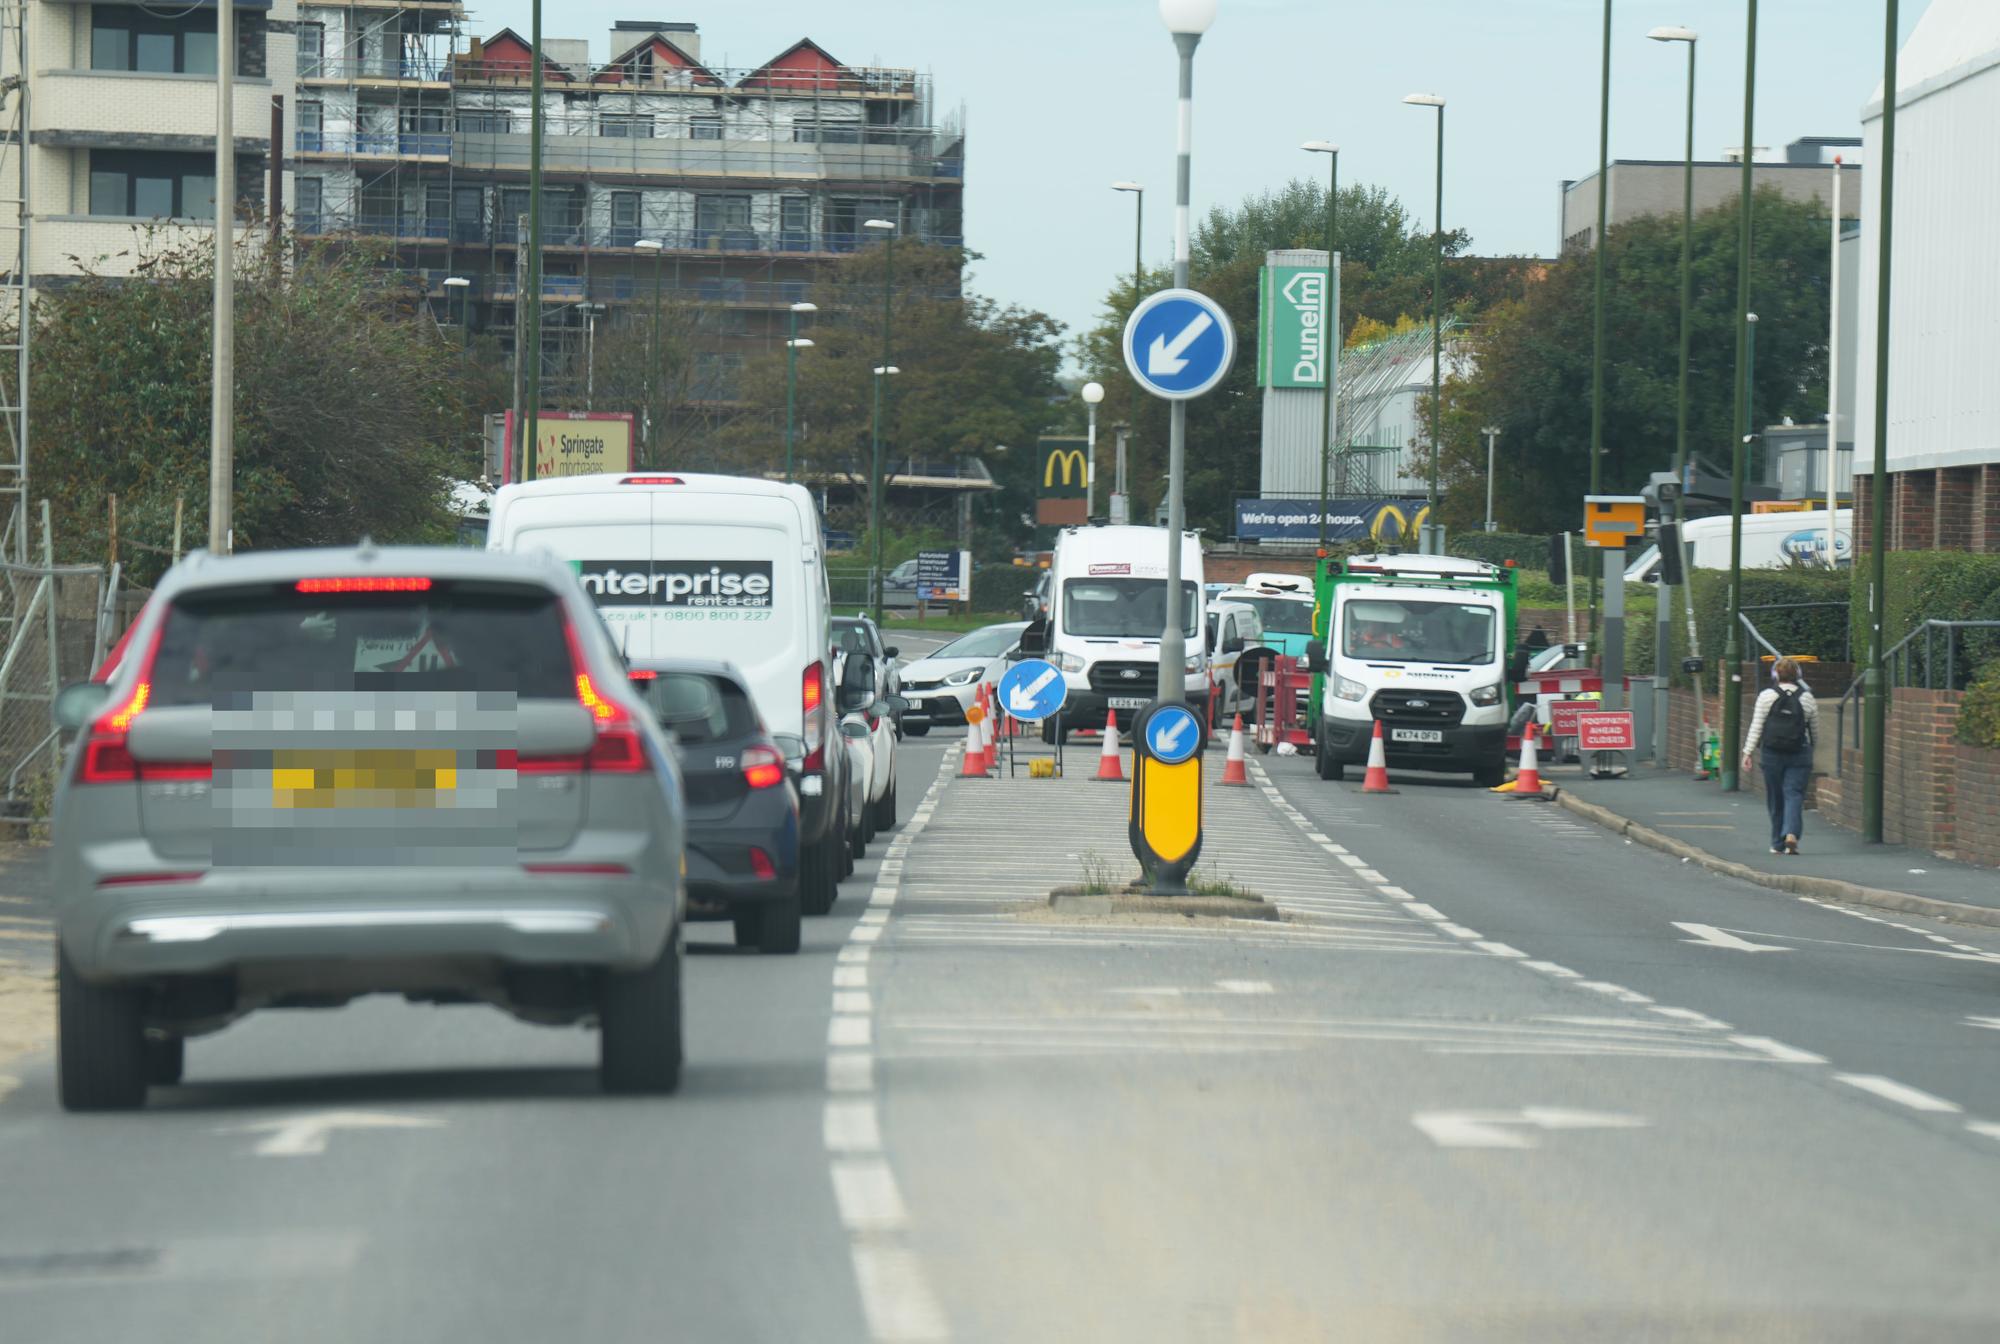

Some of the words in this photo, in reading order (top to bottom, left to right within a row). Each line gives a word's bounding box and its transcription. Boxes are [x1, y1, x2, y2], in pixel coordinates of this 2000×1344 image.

[1293, 279, 1319, 382] Dunelm
[560, 434, 604, 458] Springate
[1242, 513, 1276, 524] We're
[1277, 514, 1307, 526] open
[579, 566, 770, 602] nterprise
[687, 594, 769, 606] rent-a-car
[664, 611, 704, 621] 0800
[710, 611, 739, 621] 800
[744, 611, 771, 621] 227
